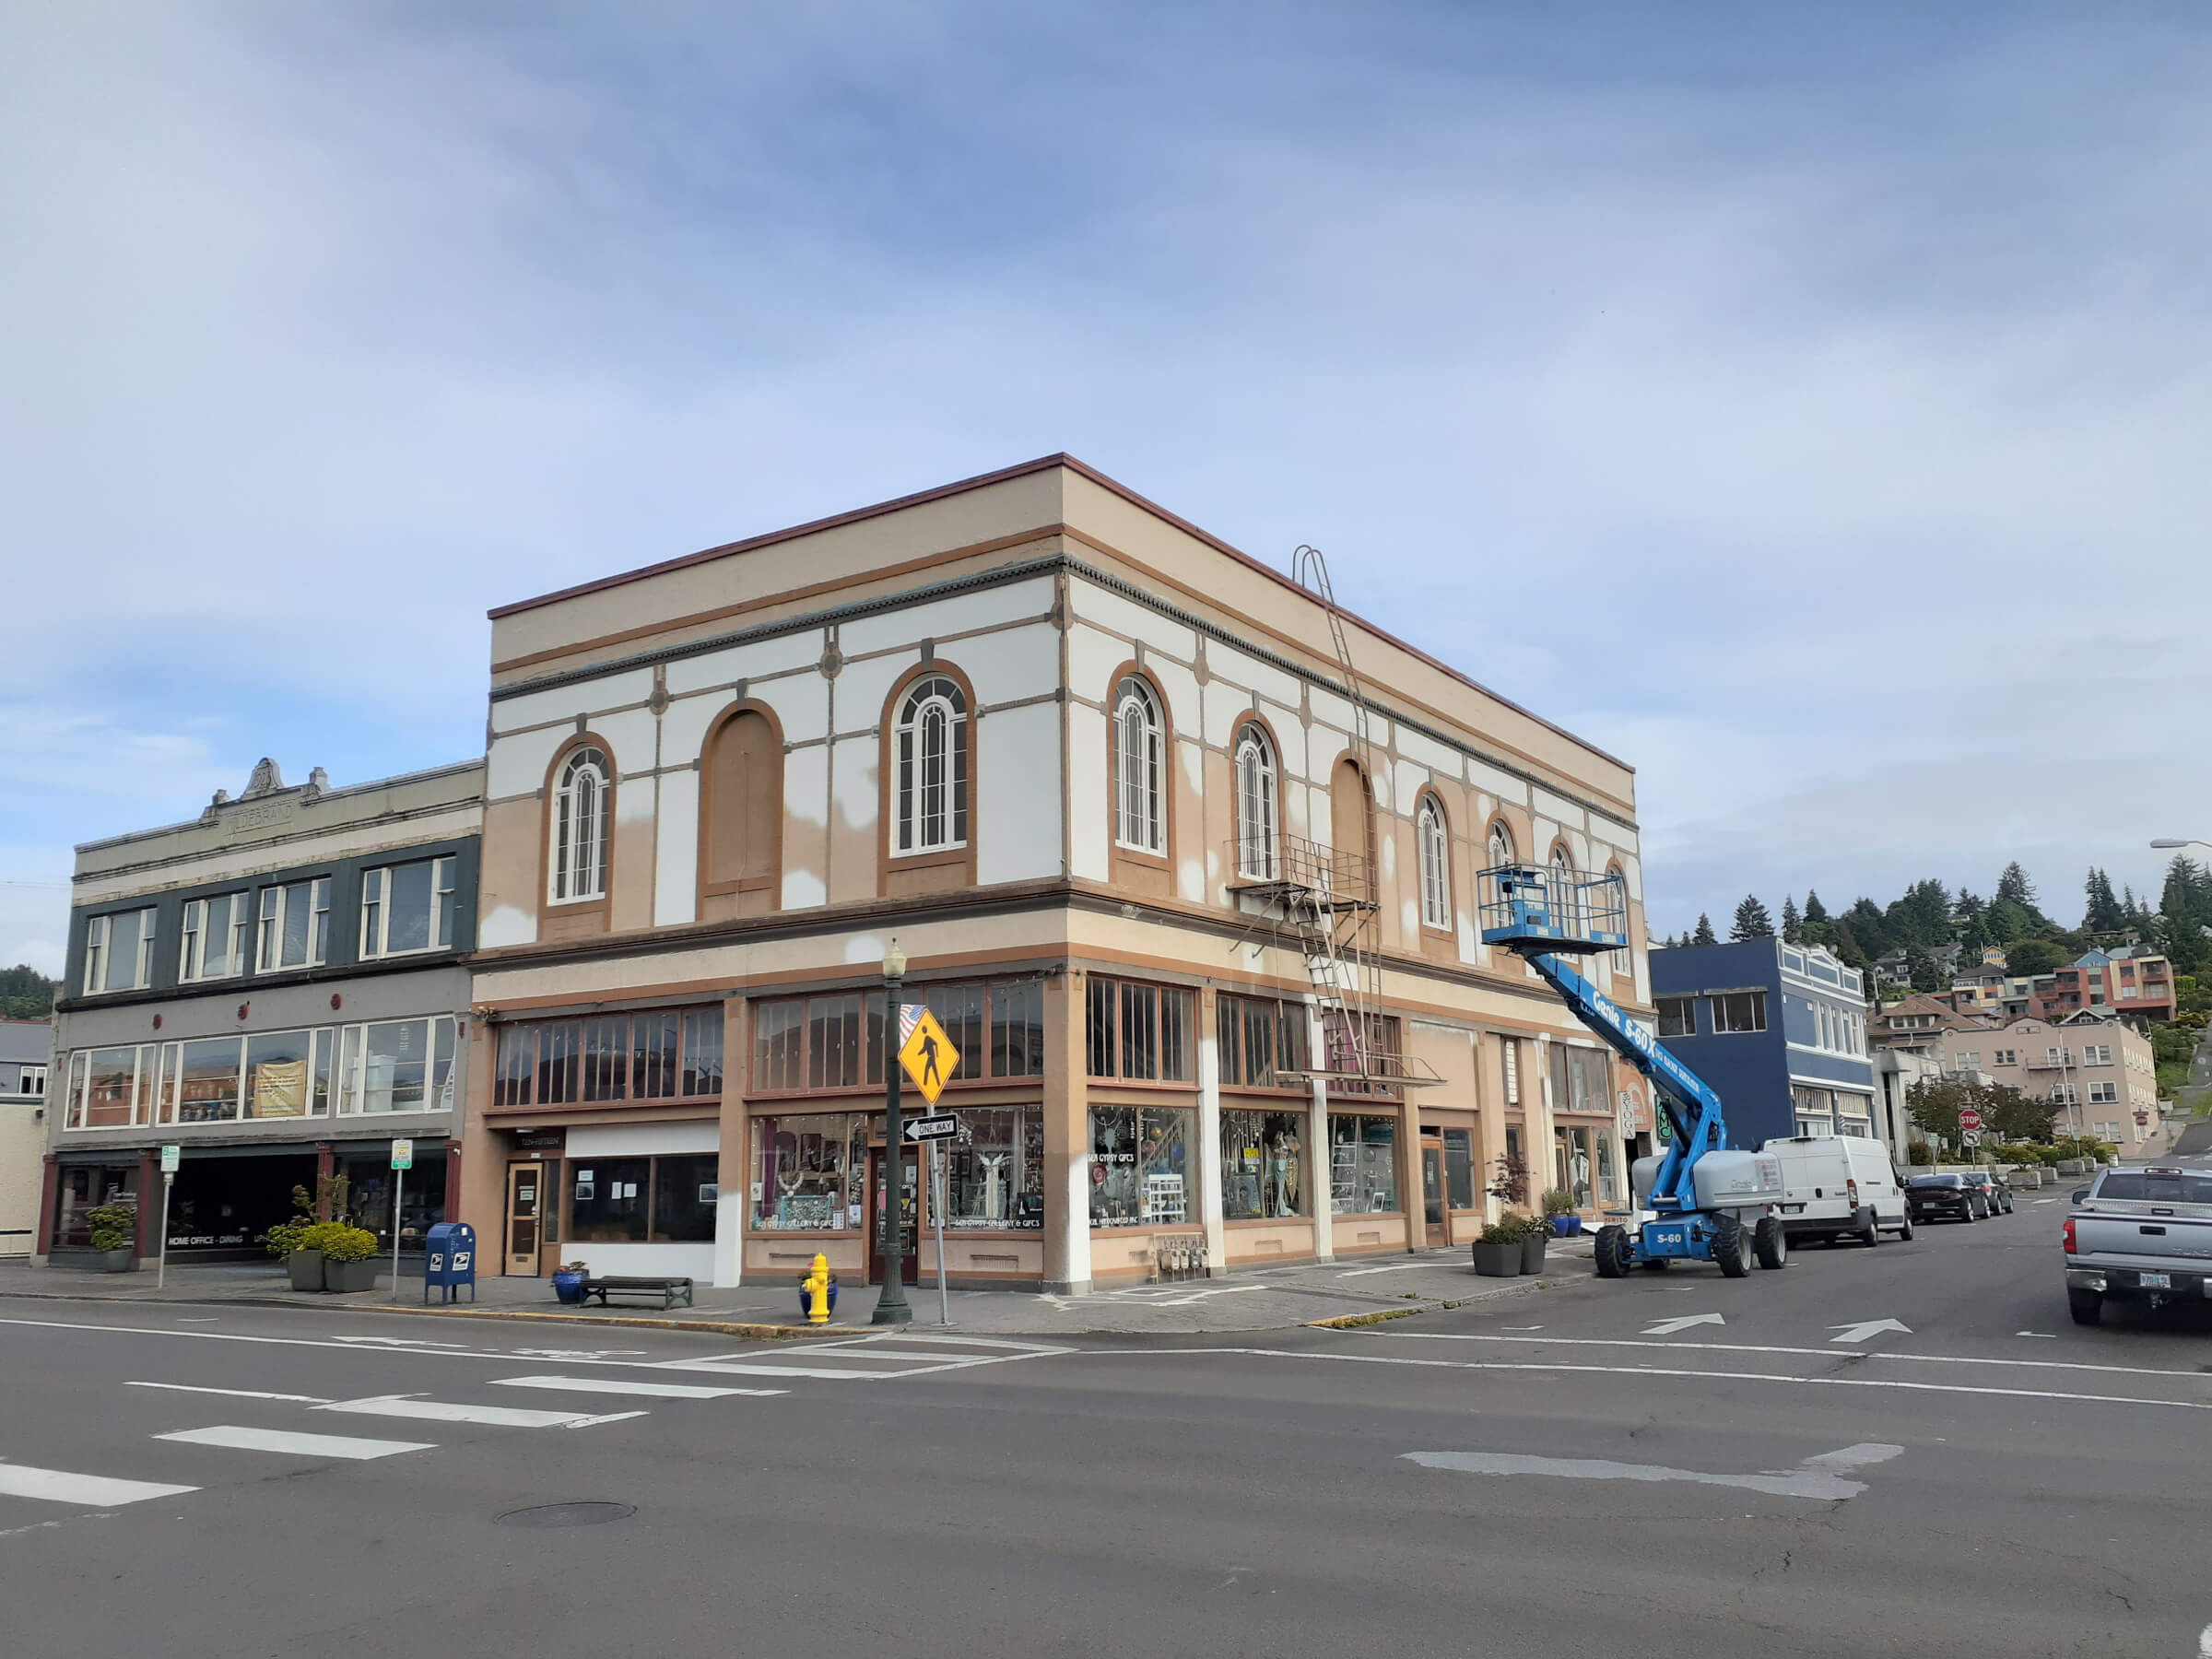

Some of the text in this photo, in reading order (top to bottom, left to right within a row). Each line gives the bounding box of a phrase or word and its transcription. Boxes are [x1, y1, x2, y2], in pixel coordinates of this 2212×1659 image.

[1593, 991, 1621, 1028] Genie
[1960, 1116, 1980, 1124] STOP
[919, 1122, 952, 1135] ONE WAY
[1100, 1153, 1118, 1162] GYPSY
[168, 1236, 189, 1245] HOME
[190, 1236, 214, 1244] OFFICE
[219, 1235, 243, 1244] DINING
[1656, 1233, 1682, 1243] S-60
